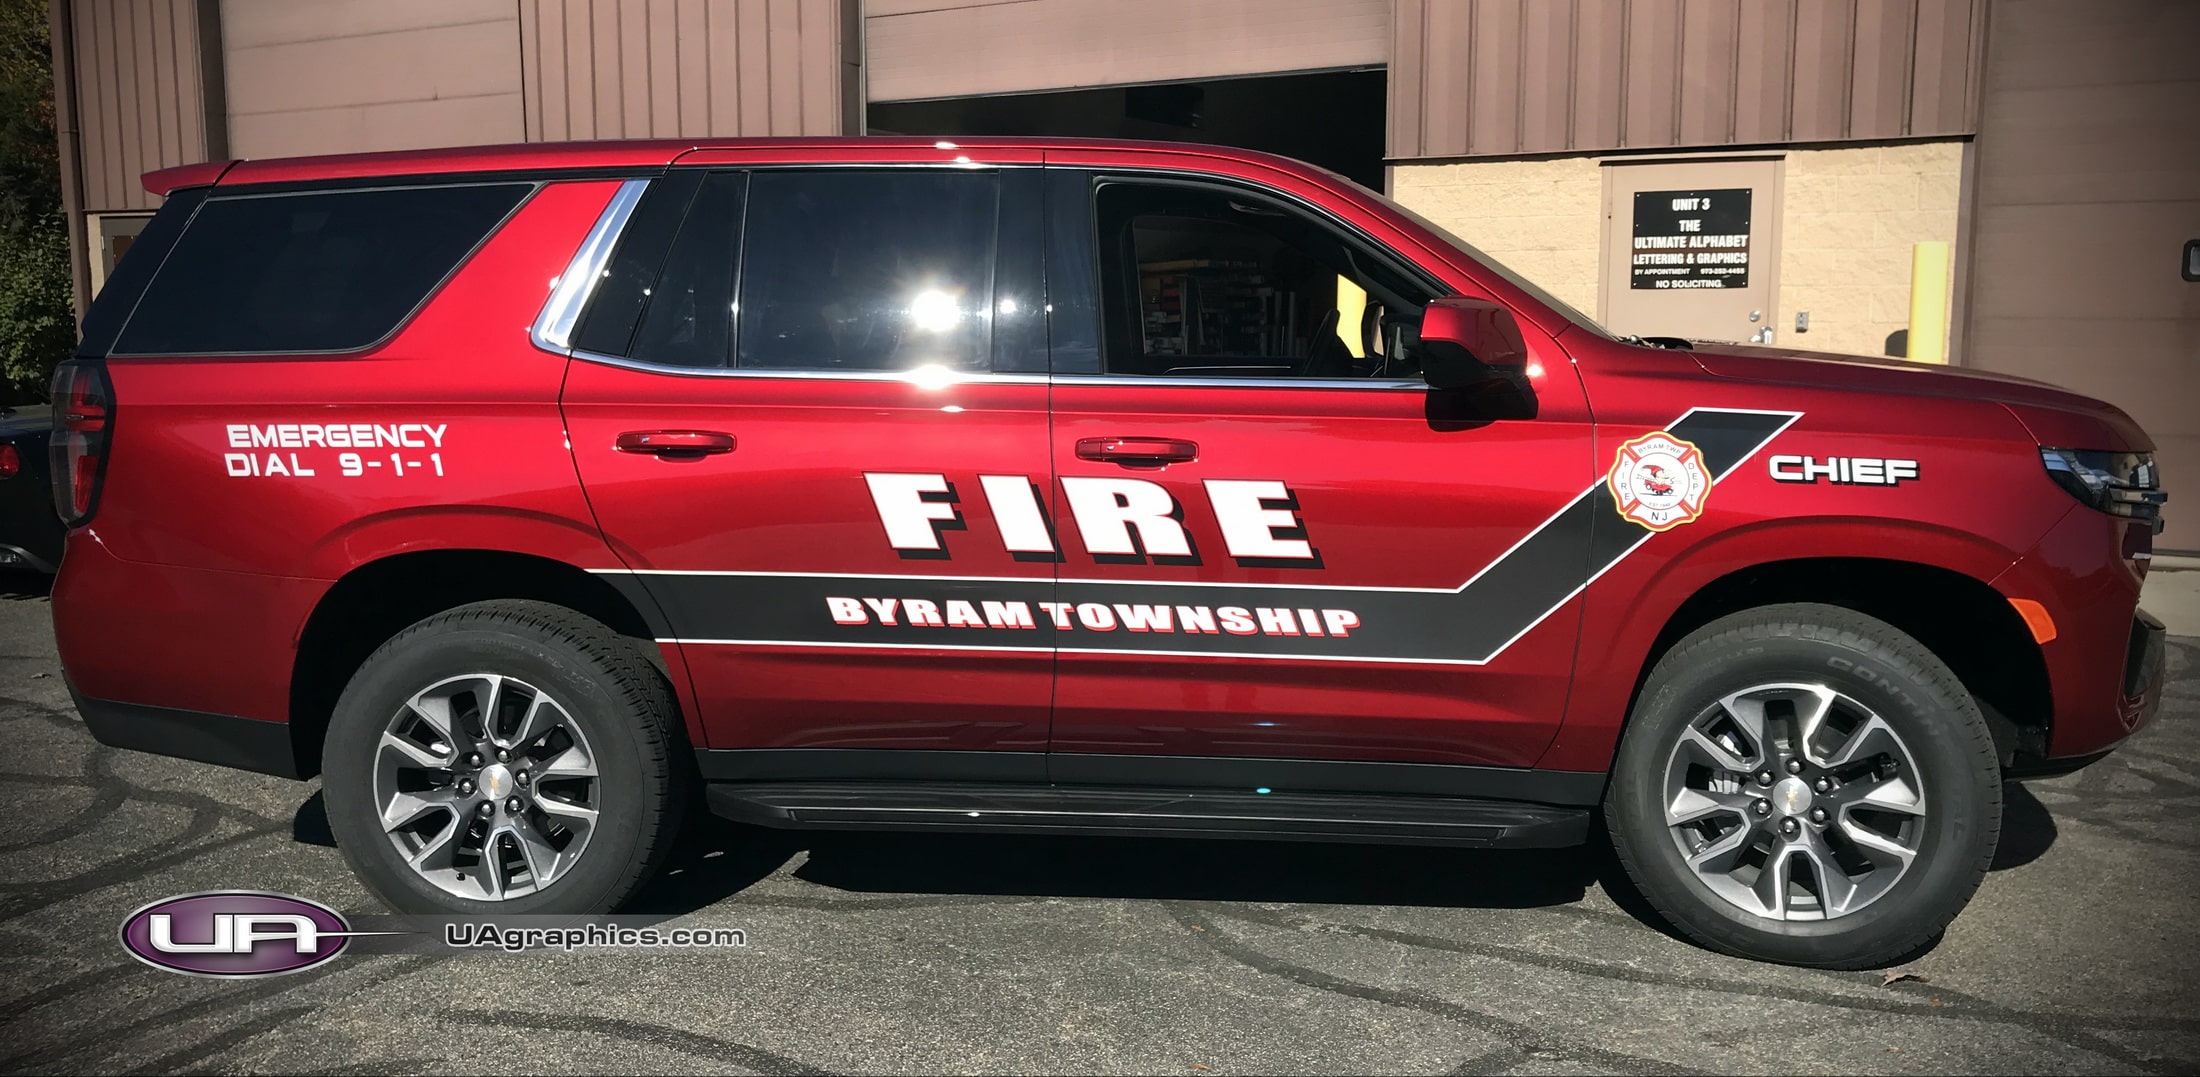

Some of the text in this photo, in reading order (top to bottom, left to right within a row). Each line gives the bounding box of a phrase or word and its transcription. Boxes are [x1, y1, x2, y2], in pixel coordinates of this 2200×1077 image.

[1672, 198, 1711, 211] UNIT 3
[1679, 219, 1701, 232] THE
[1634, 235, 1748, 249] ULTIMATE ALPHABET
[1633, 253, 1747, 265] LETTERING & GRAPHICS
[1655, 280, 1669, 288] NO
[226, 424, 447, 448] EMERGENCY
[1637, 444, 1681, 454] BYRAM TWP
[224, 453, 444, 477] DIAL 9-1-1
[1769, 455, 1920, 487] CHIEF
[862, 471, 1326, 569] FIRE
[826, 596, 1361, 637] BYRAM TOWNSHIP
